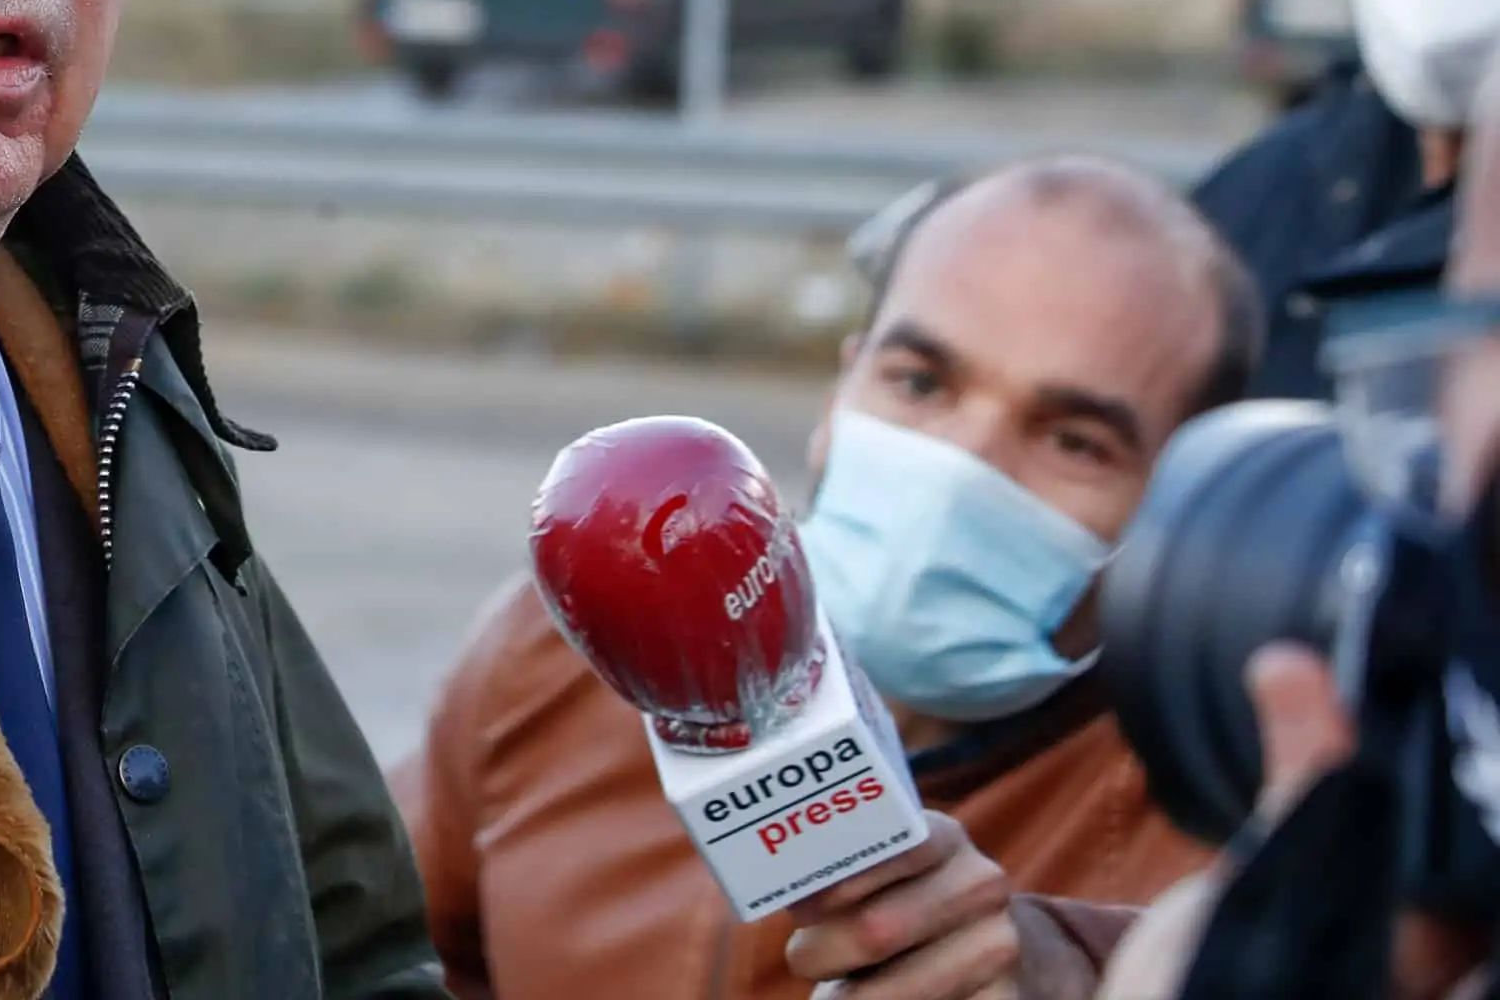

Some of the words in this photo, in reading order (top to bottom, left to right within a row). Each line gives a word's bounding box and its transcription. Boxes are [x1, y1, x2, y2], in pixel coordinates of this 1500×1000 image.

[703, 737, 864, 822] europa
[756, 776, 884, 855] press
[747, 829, 911, 910] www.europapress.es
